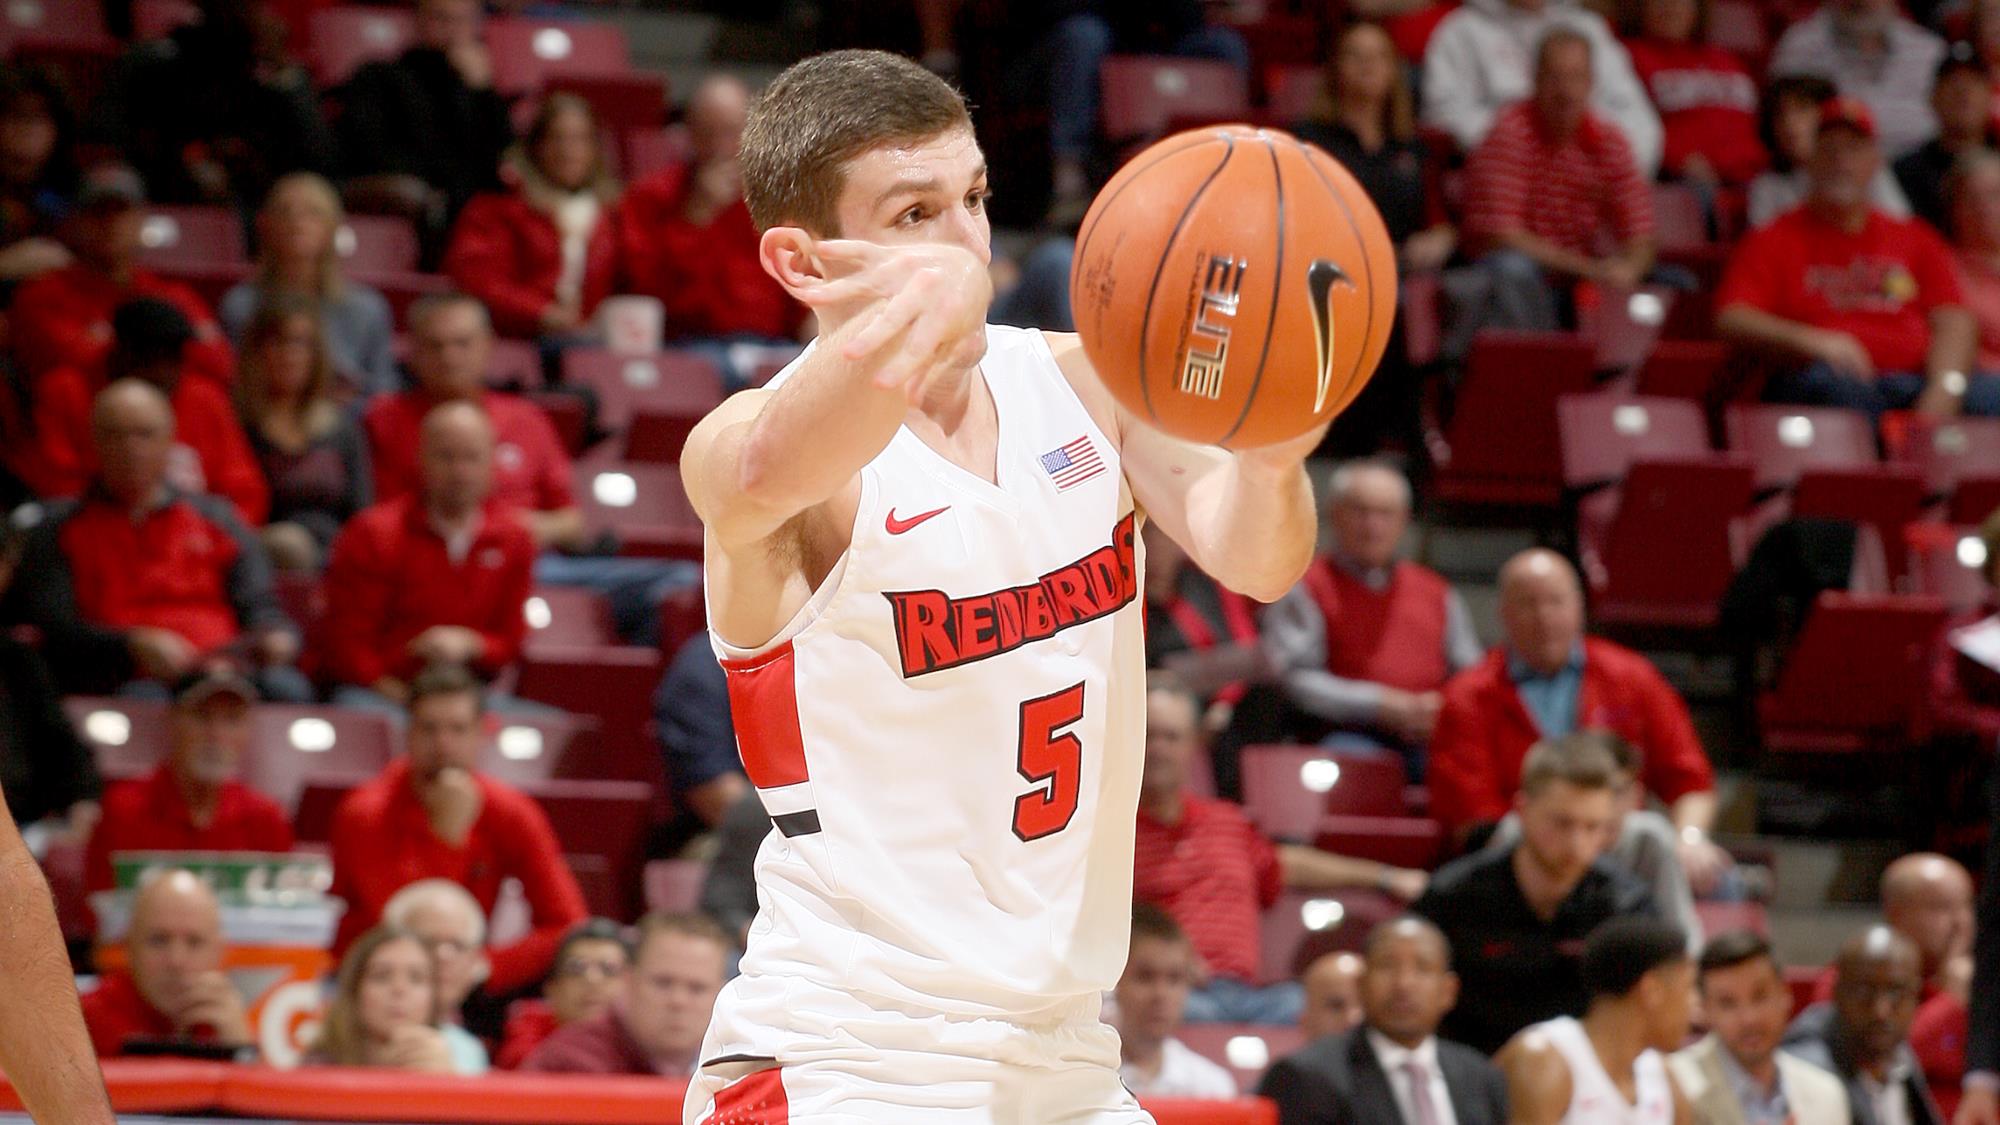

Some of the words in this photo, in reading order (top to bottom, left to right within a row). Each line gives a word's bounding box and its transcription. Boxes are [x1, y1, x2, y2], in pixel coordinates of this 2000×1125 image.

[1181, 255, 1247, 399] ELITE
[880, 510, 1137, 679] REDBRDS
[1011, 680, 1085, 842] 5
